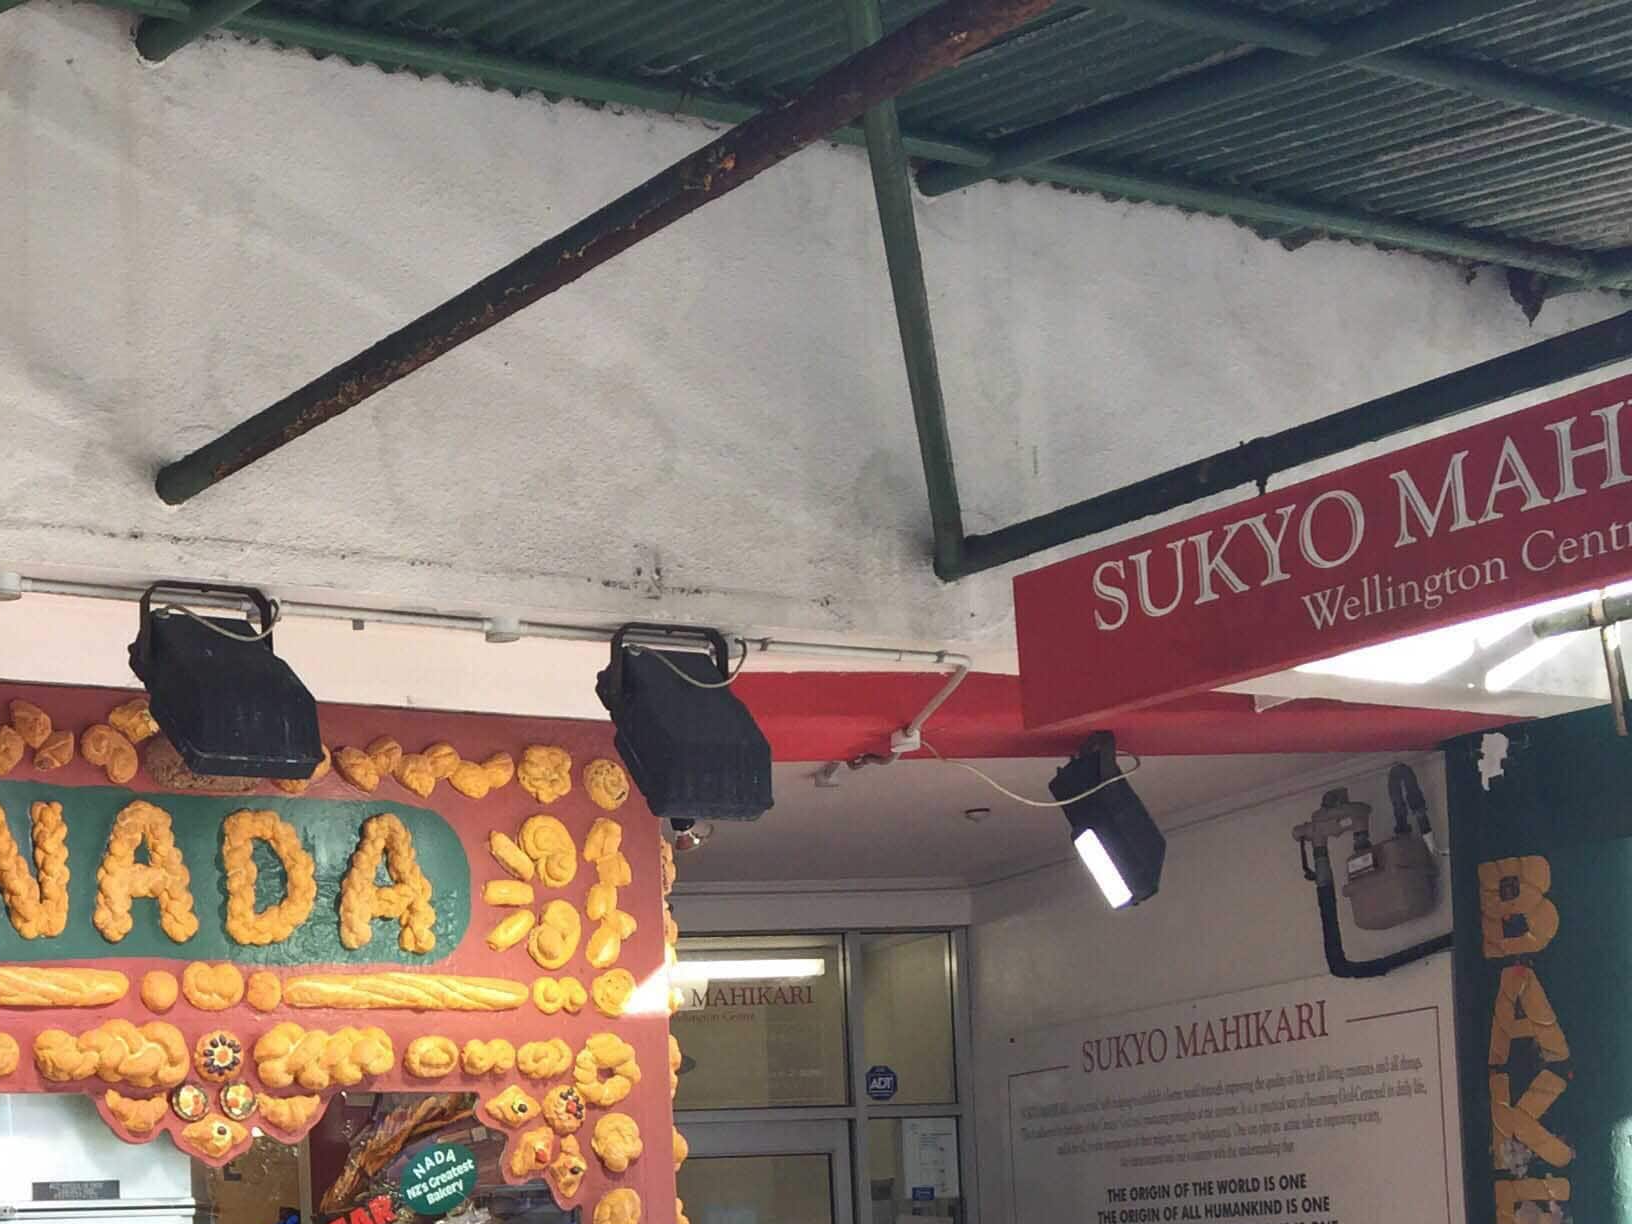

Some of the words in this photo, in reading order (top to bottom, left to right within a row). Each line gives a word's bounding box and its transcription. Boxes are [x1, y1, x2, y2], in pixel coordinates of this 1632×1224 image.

[1092, 489, 1366, 631] SUKYO
[1389, 399, 1632, 548] MAH
[1301, 556, 1509, 631] Wellington
[690, 985, 816, 1007] MAHIKARI
[1081, 1028, 1169, 1073] SUKYO
[1174, 1000, 1329, 1060] MAHIKARI
[869, 1076, 894, 1090] ADT
[412, 1148, 457, 1179] NADA
[428, 1159, 475, 1188] Greatest
[426, 1179, 464, 1205] Bakery
[1107, 1187, 1128, 1203] THE
[1129, 1184, 1171, 1202] ORIGIN
[1174, 1182, 1190, 1198] OF
[1191, 1180, 1214, 1198] THE
[1216, 1176, 1260, 1196] WORLD
[1263, 1175, 1276, 1192] IS
[1278, 1173, 1307, 1191] ONE
[1097, 1210, 1118, 1224] THE
[1120, 1206, 1161, 1224] ORIGIN
[1164, 1206, 1180, 1221] OF
[1181, 1204, 1202, 1221] ALL
[1205, 1199, 1282, 1219] HUMANKIND
[1286, 1198, 1299, 1215] IS
[1301, 1196, 1330, 1214] ONE
